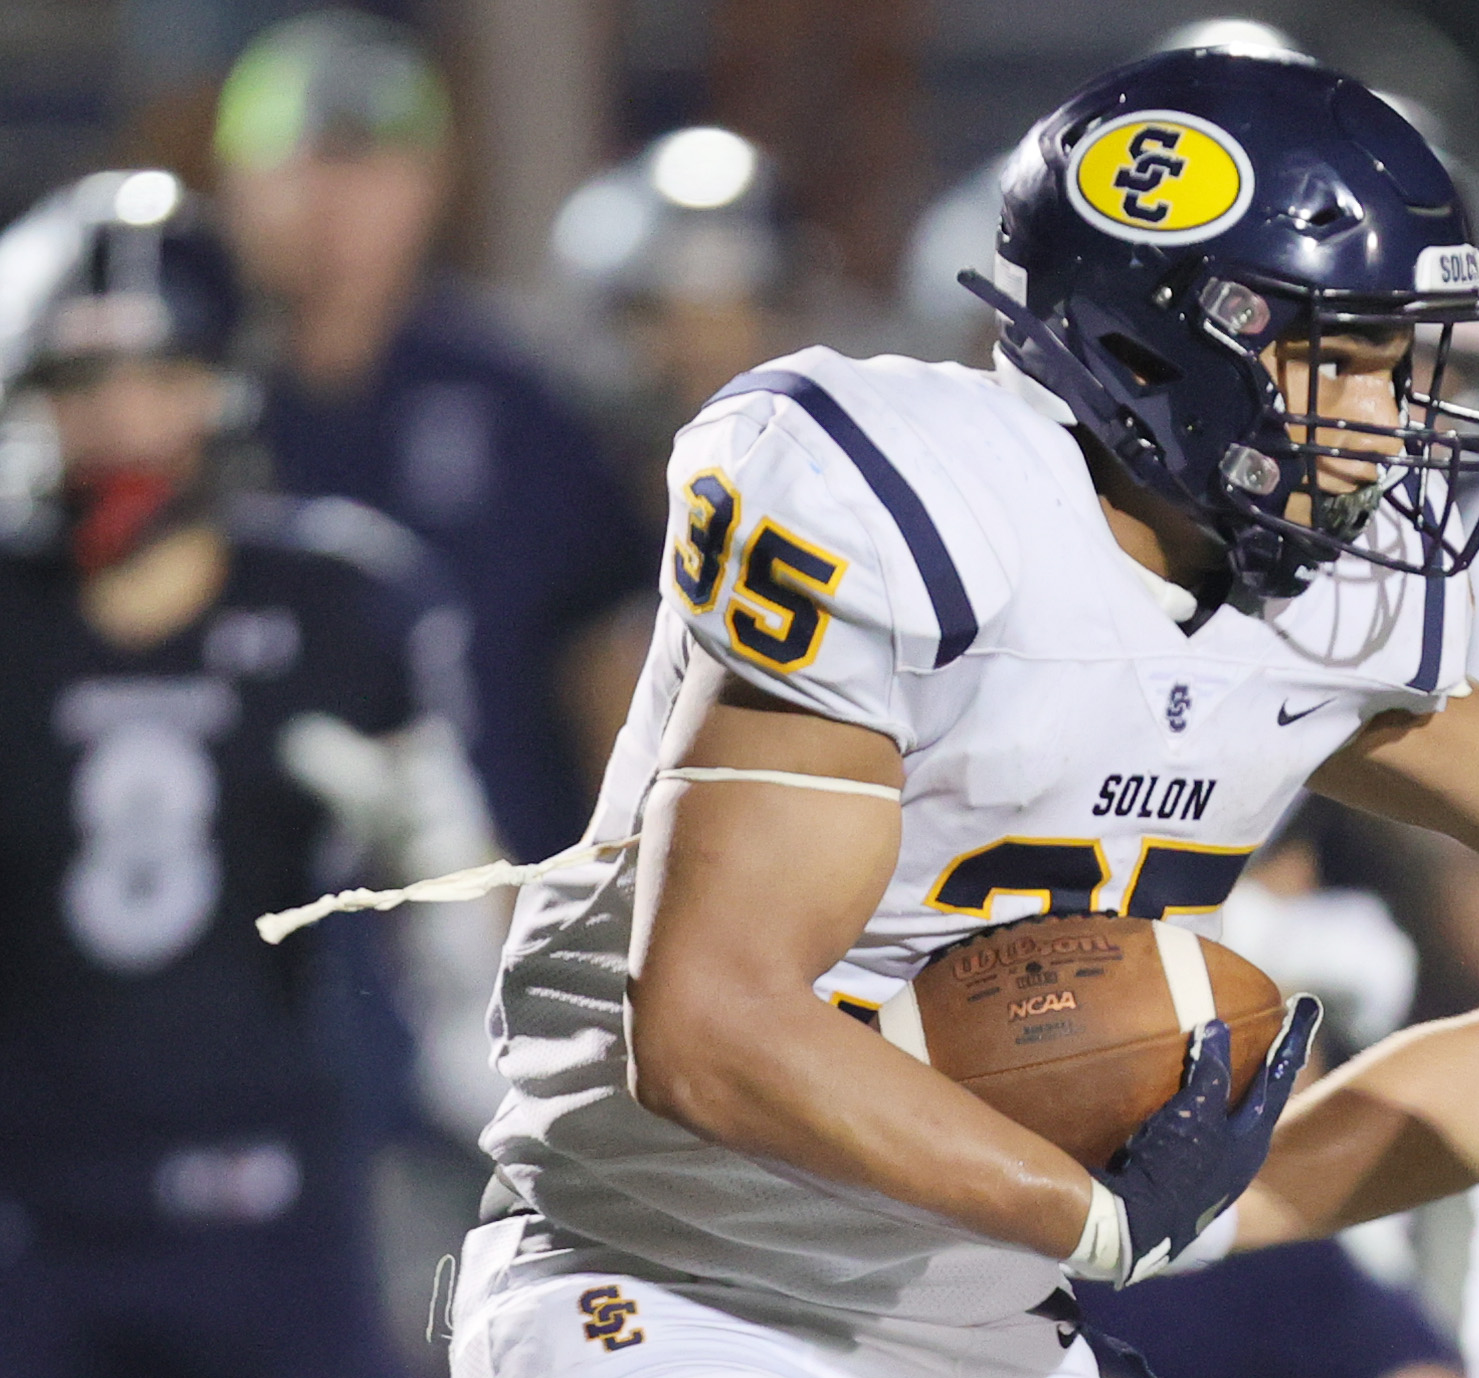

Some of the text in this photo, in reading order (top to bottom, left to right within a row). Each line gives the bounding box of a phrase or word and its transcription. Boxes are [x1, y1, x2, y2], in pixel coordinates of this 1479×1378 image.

[664, 466, 850, 675] 35
[1092, 773, 1217, 820] SOLON
[1007, 991, 1077, 1021] NCAA
